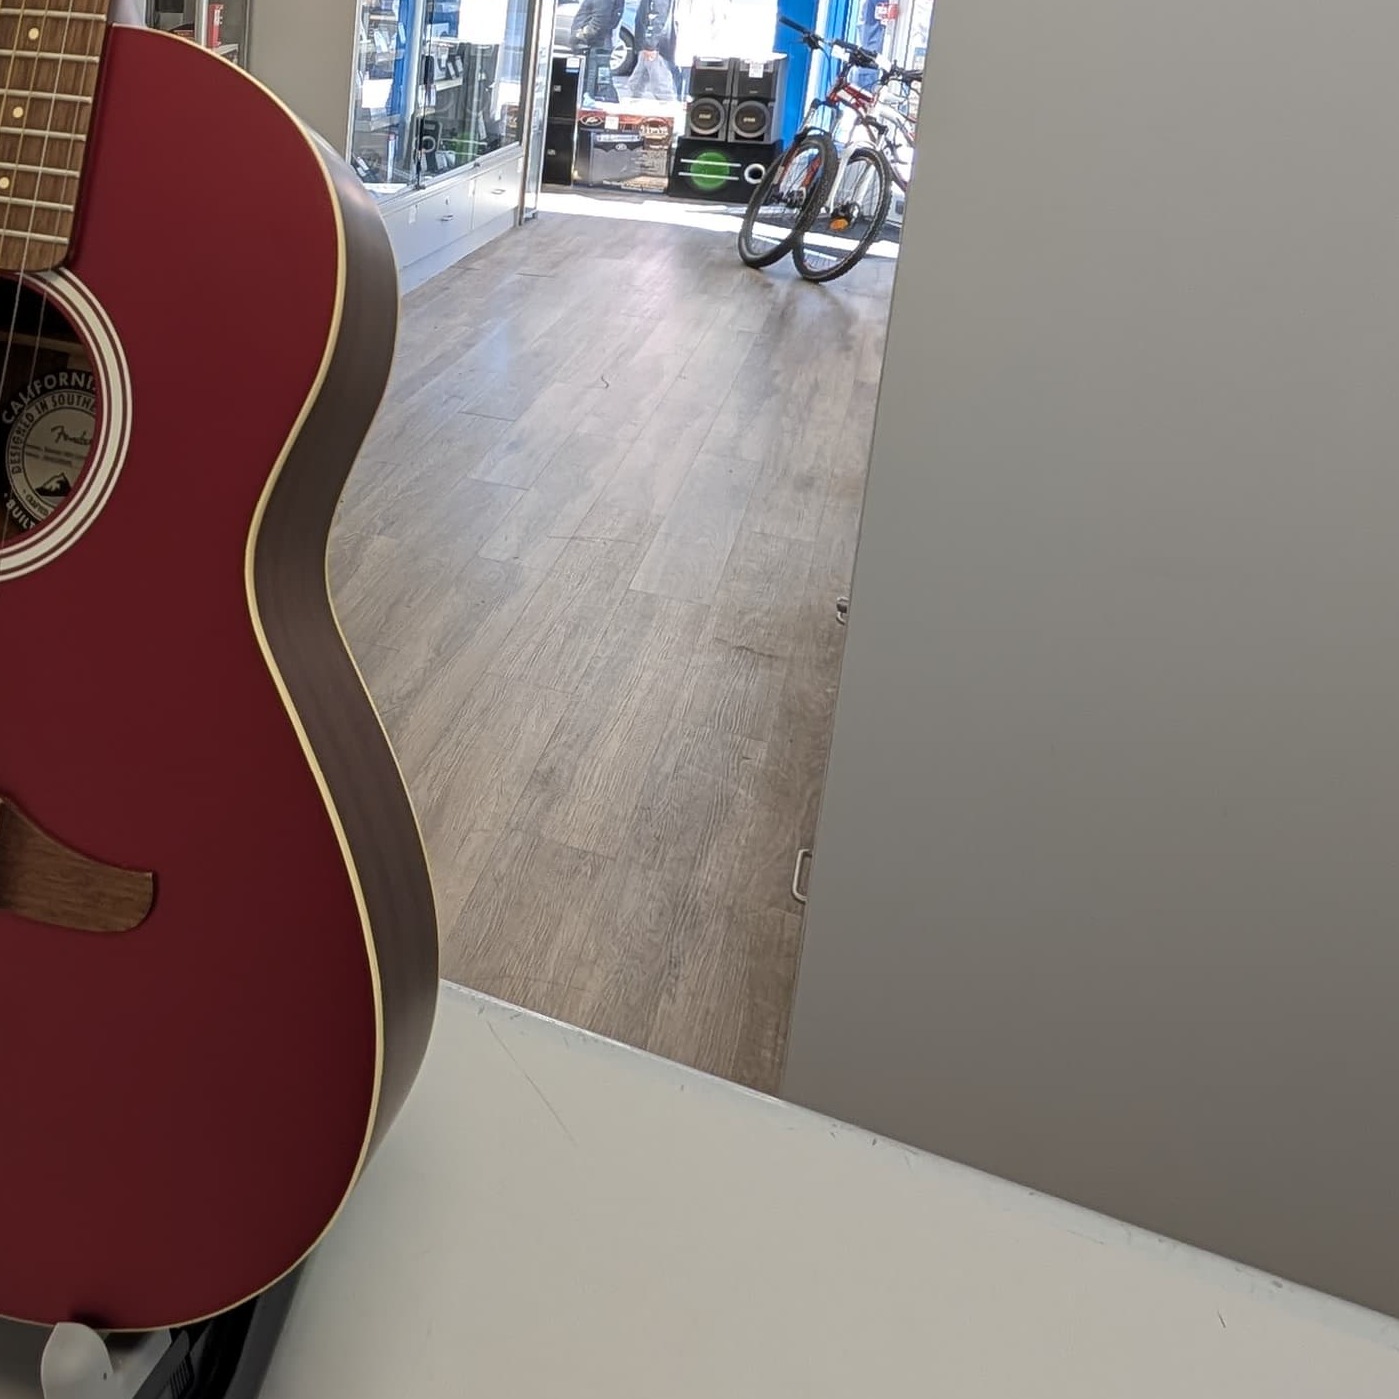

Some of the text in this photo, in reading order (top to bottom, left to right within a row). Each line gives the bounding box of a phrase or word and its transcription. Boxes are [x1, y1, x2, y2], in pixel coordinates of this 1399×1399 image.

[2, 371, 96, 424] CALIFORNI
[10, 413, 35, 475] DESIGNED
[34, 399, 50, 414] IN
